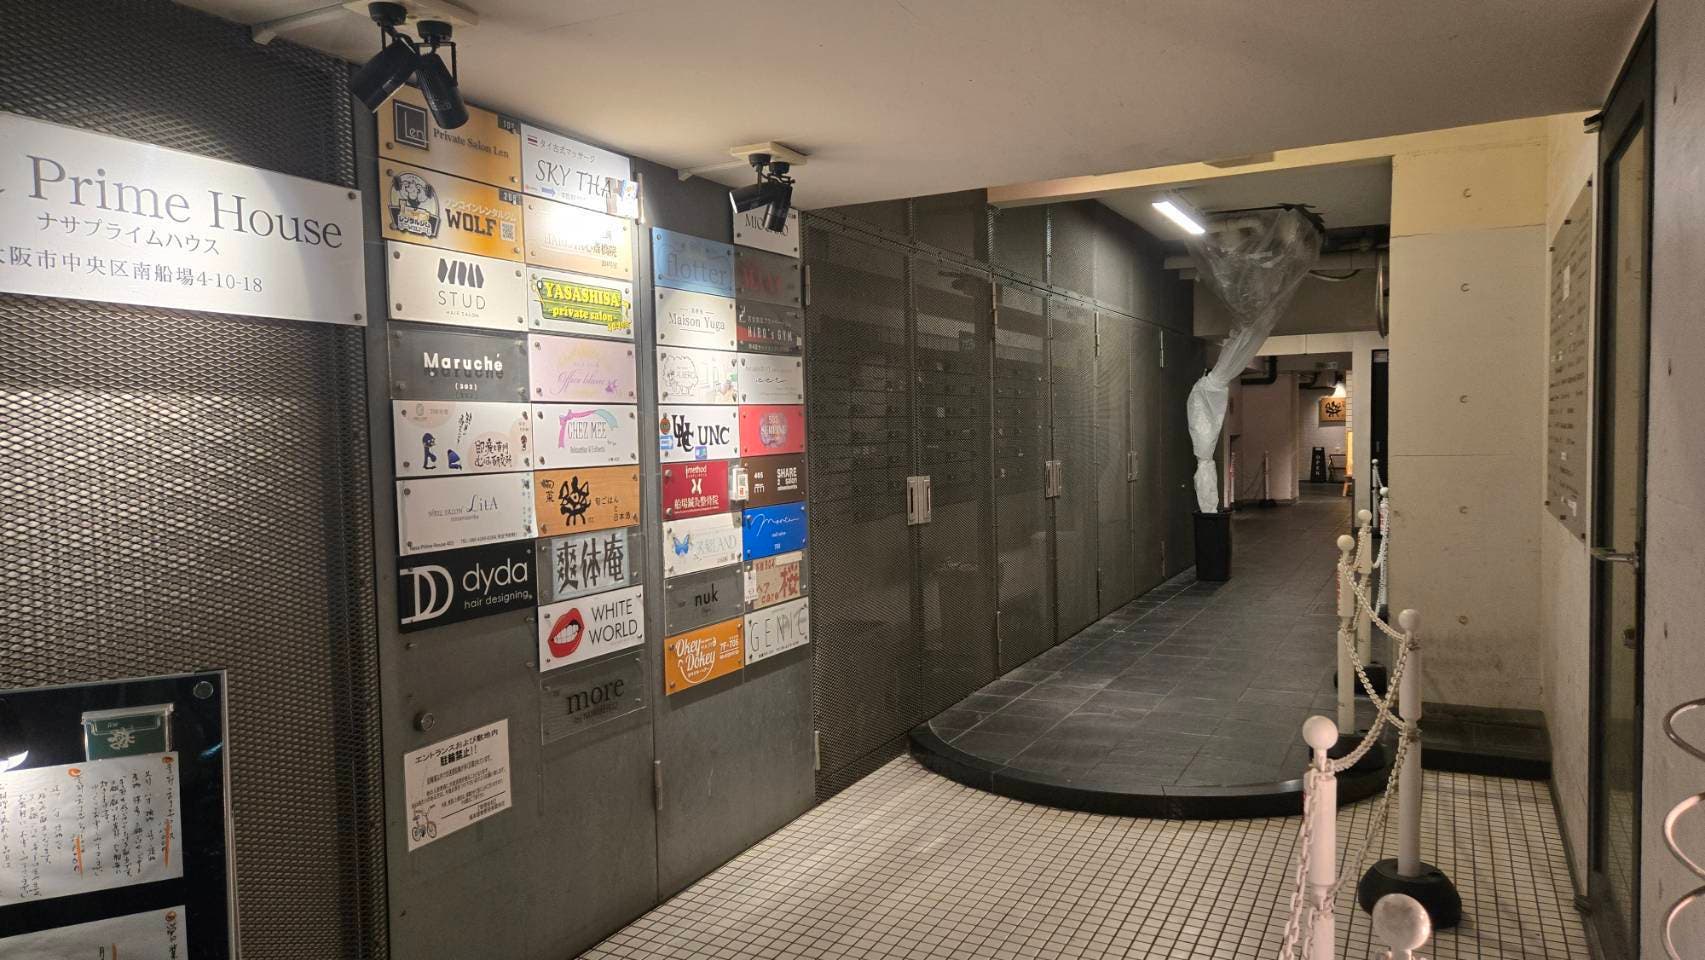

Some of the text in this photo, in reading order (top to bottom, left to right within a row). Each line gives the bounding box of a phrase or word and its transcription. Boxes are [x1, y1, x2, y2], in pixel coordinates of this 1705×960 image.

[433, 127, 466, 146] Private
[467, 138, 492, 154] Salon
[536, 159, 571, 187] SKY
[26, 154, 343, 249] Prime House
[445, 207, 497, 236] WOLF
[37, 211, 221, 257] ナサプライムハウス
[438, 290, 486, 310] STUD
[423, 352, 504, 372] Maruché
[567, 421, 589, 440] CHEZ
[698, 425, 730, 446] UNC
[777, 467, 798, 477] SHARE
[461, 557, 529, 596] dyda
[464, 597, 484, 610] hair
[695, 583, 719, 608] nuk
[591, 599, 634, 622] WHITE
[588, 619, 639, 646] WORLD
[675, 637, 702, 657] Okey
[685, 652, 716, 672] Dokey
[566, 677, 626, 716] more
